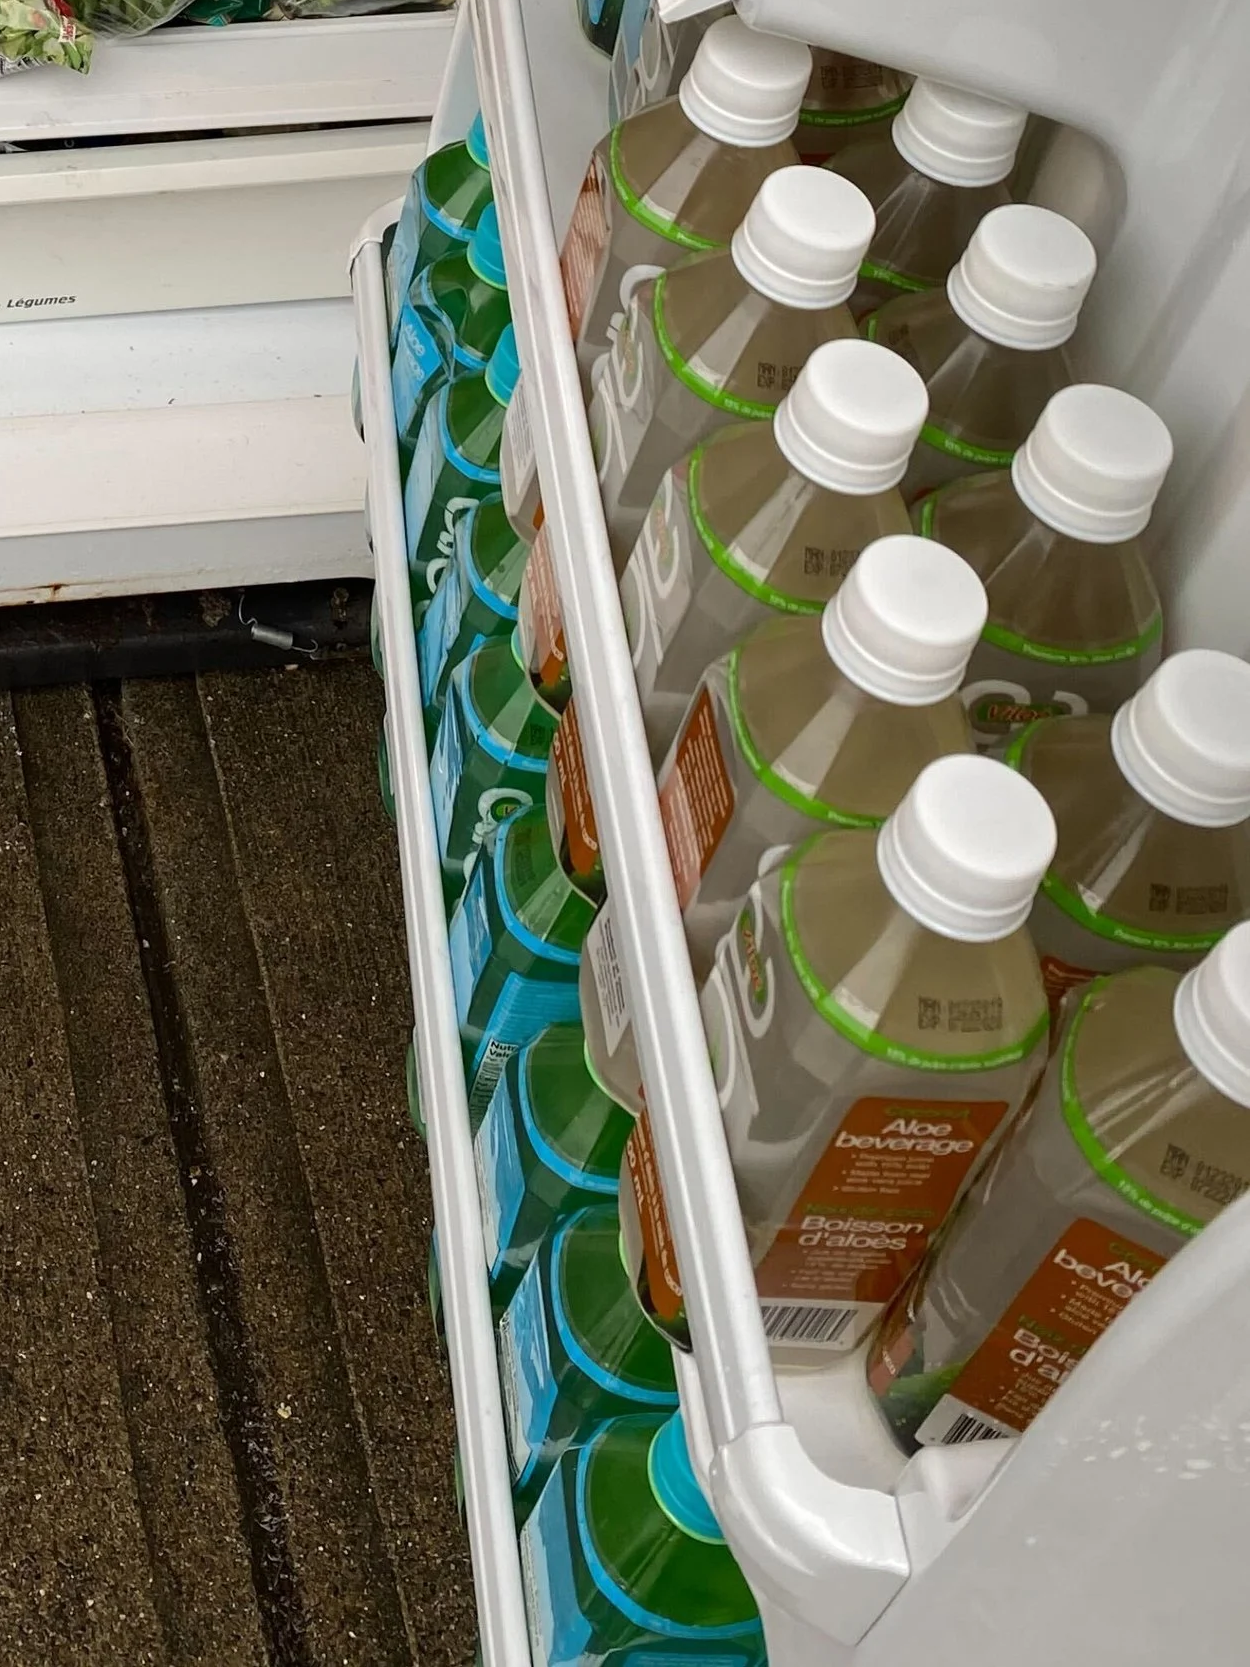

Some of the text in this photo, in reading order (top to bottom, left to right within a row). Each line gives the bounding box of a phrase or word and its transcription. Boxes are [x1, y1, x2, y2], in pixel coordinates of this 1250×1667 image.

[7, 295, 76, 309] Légumes
[882, 1118, 952, 1136] Aloe
[835, 1131, 974, 1155] beverage
[801, 1215, 924, 1234] Boisson
[799, 1233, 907, 1250] d'aloès
